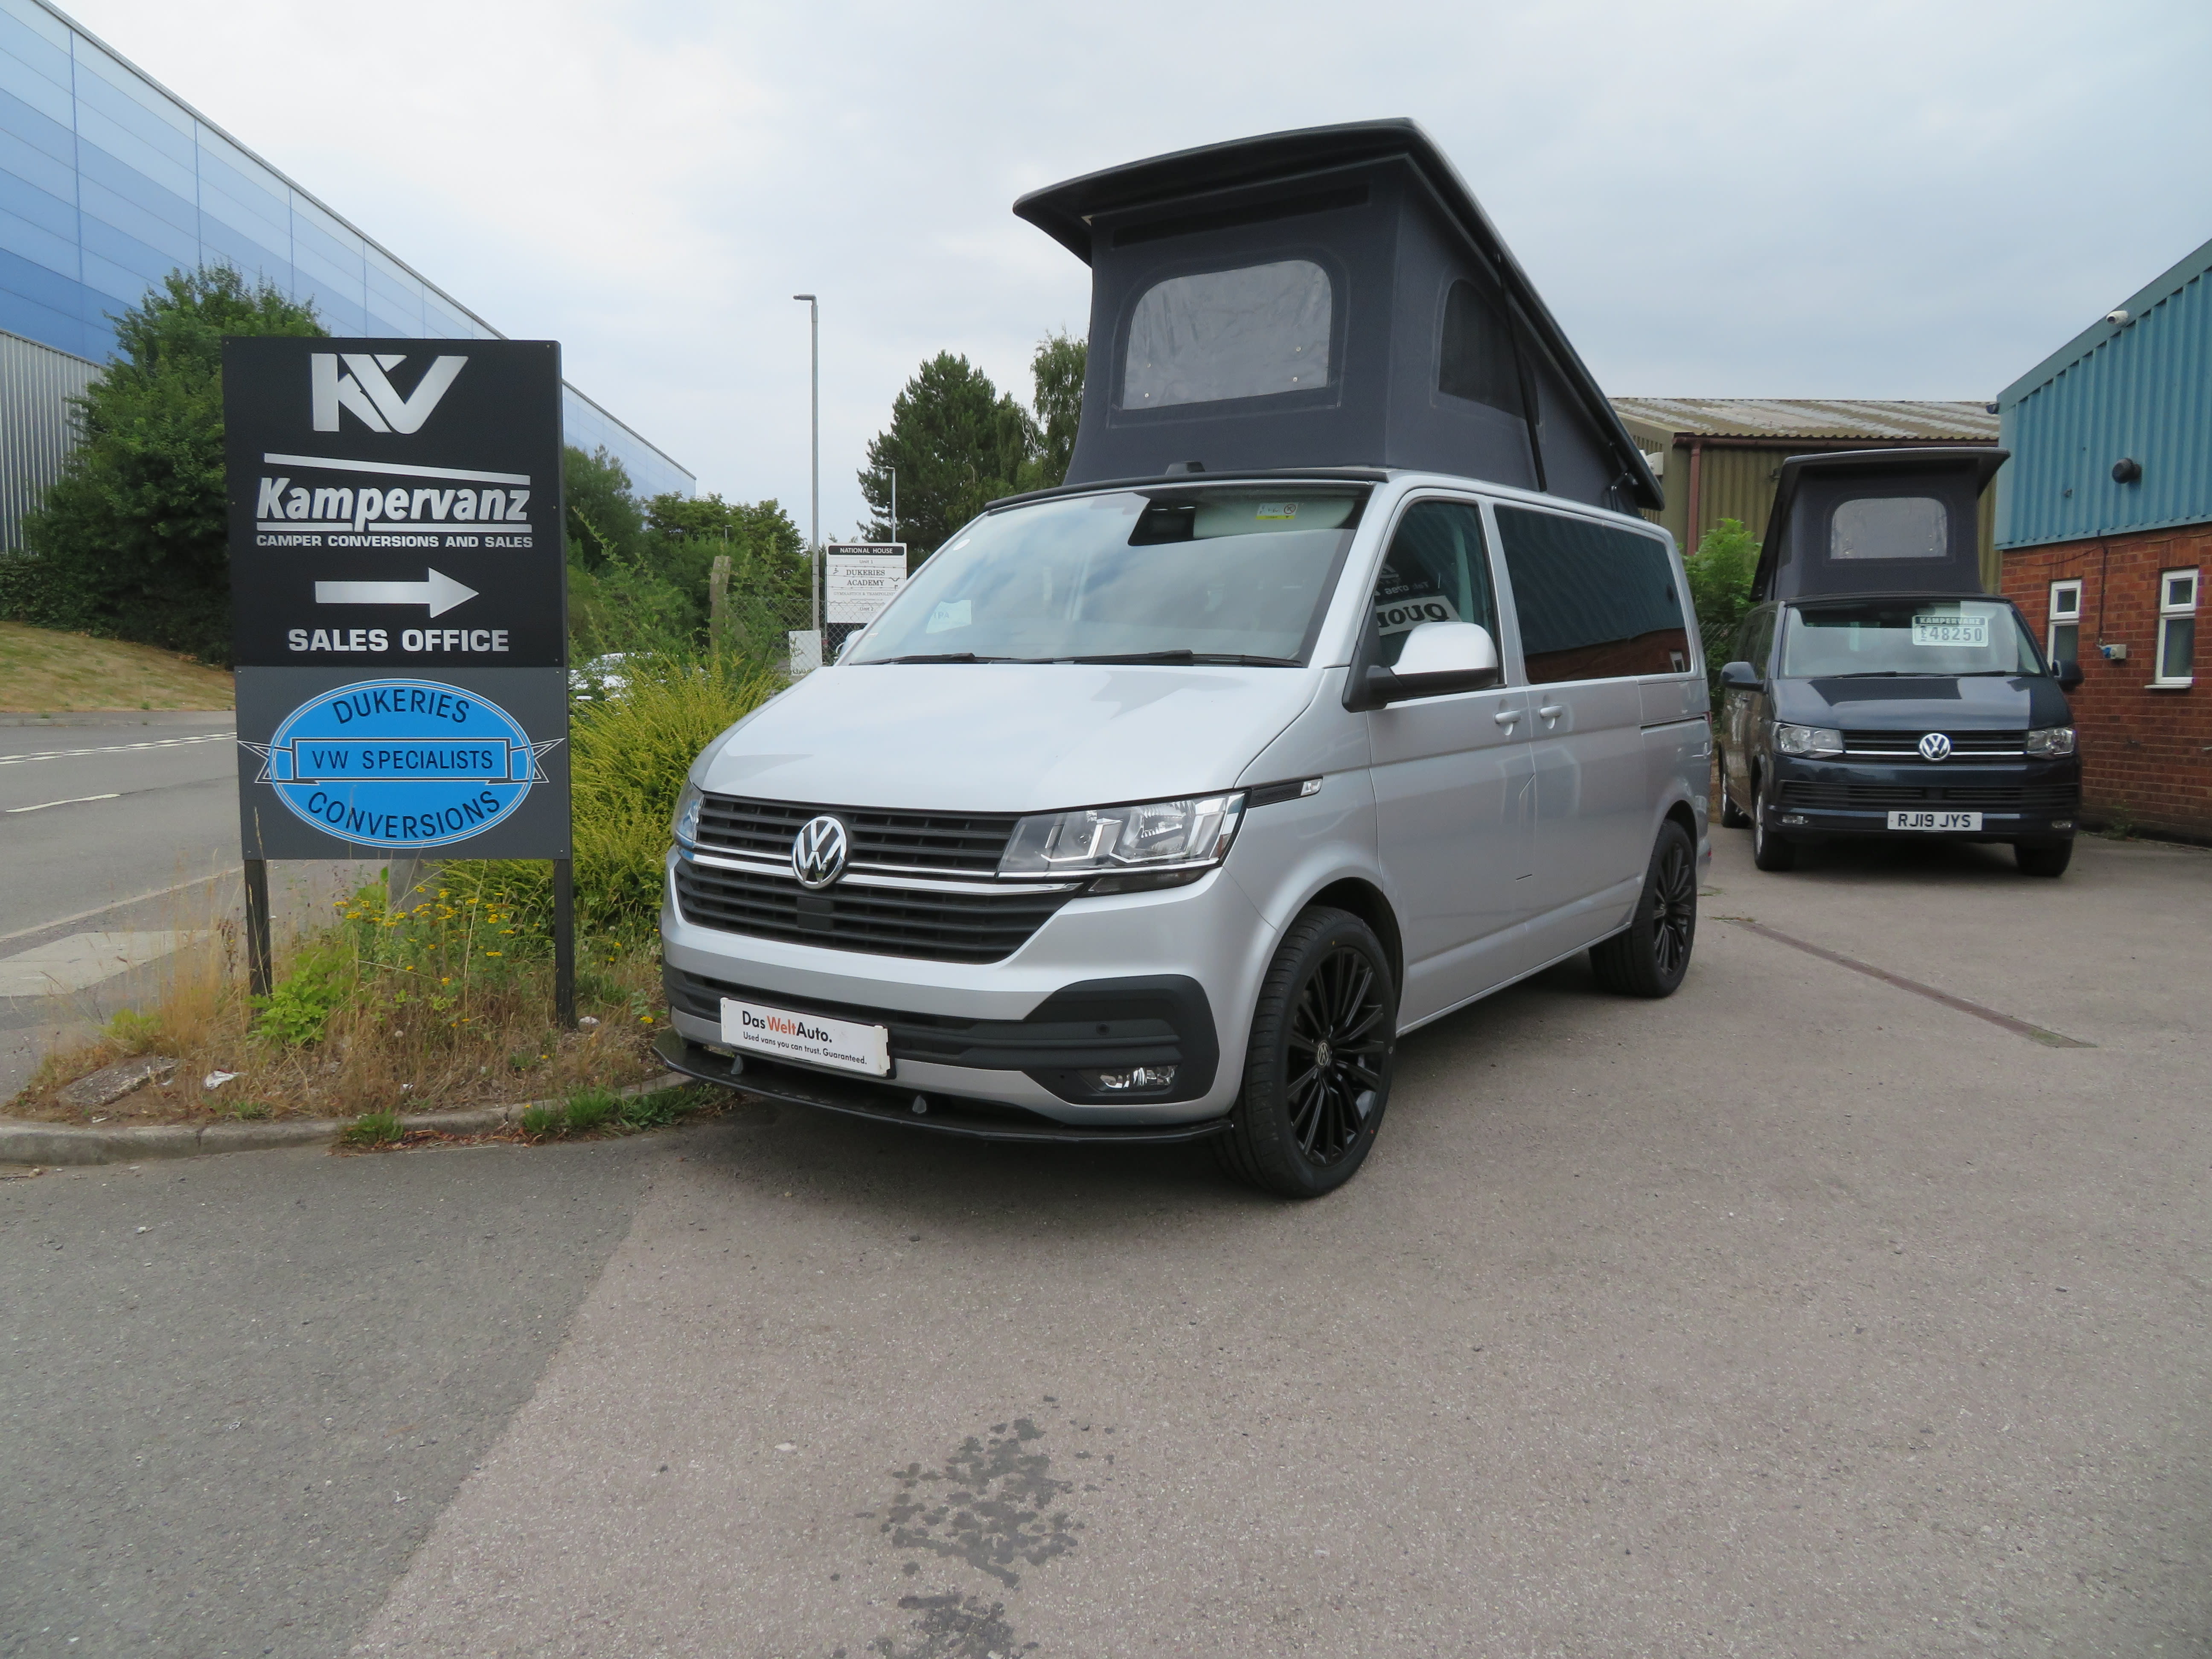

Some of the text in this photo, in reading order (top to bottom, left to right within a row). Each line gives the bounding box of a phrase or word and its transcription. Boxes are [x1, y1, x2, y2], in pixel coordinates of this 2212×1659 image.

[256, 477, 530, 533] Kampervanz
[257, 535, 533, 548] CAMPER CONVERSIONS AND SALES
[288, 629, 509, 652] SALES OFFICE
[332, 688, 470, 725] DUKERIES
[312, 750, 493, 769] VW SPECIALISTS
[308, 791, 501, 839] CONVERSIONS
[1898, 814, 1971, 828] RJ19 JYS
[742, 1010, 765, 1029] Das
[743, 1031, 867, 1065] Used vans you can trust. Guaranteed.
